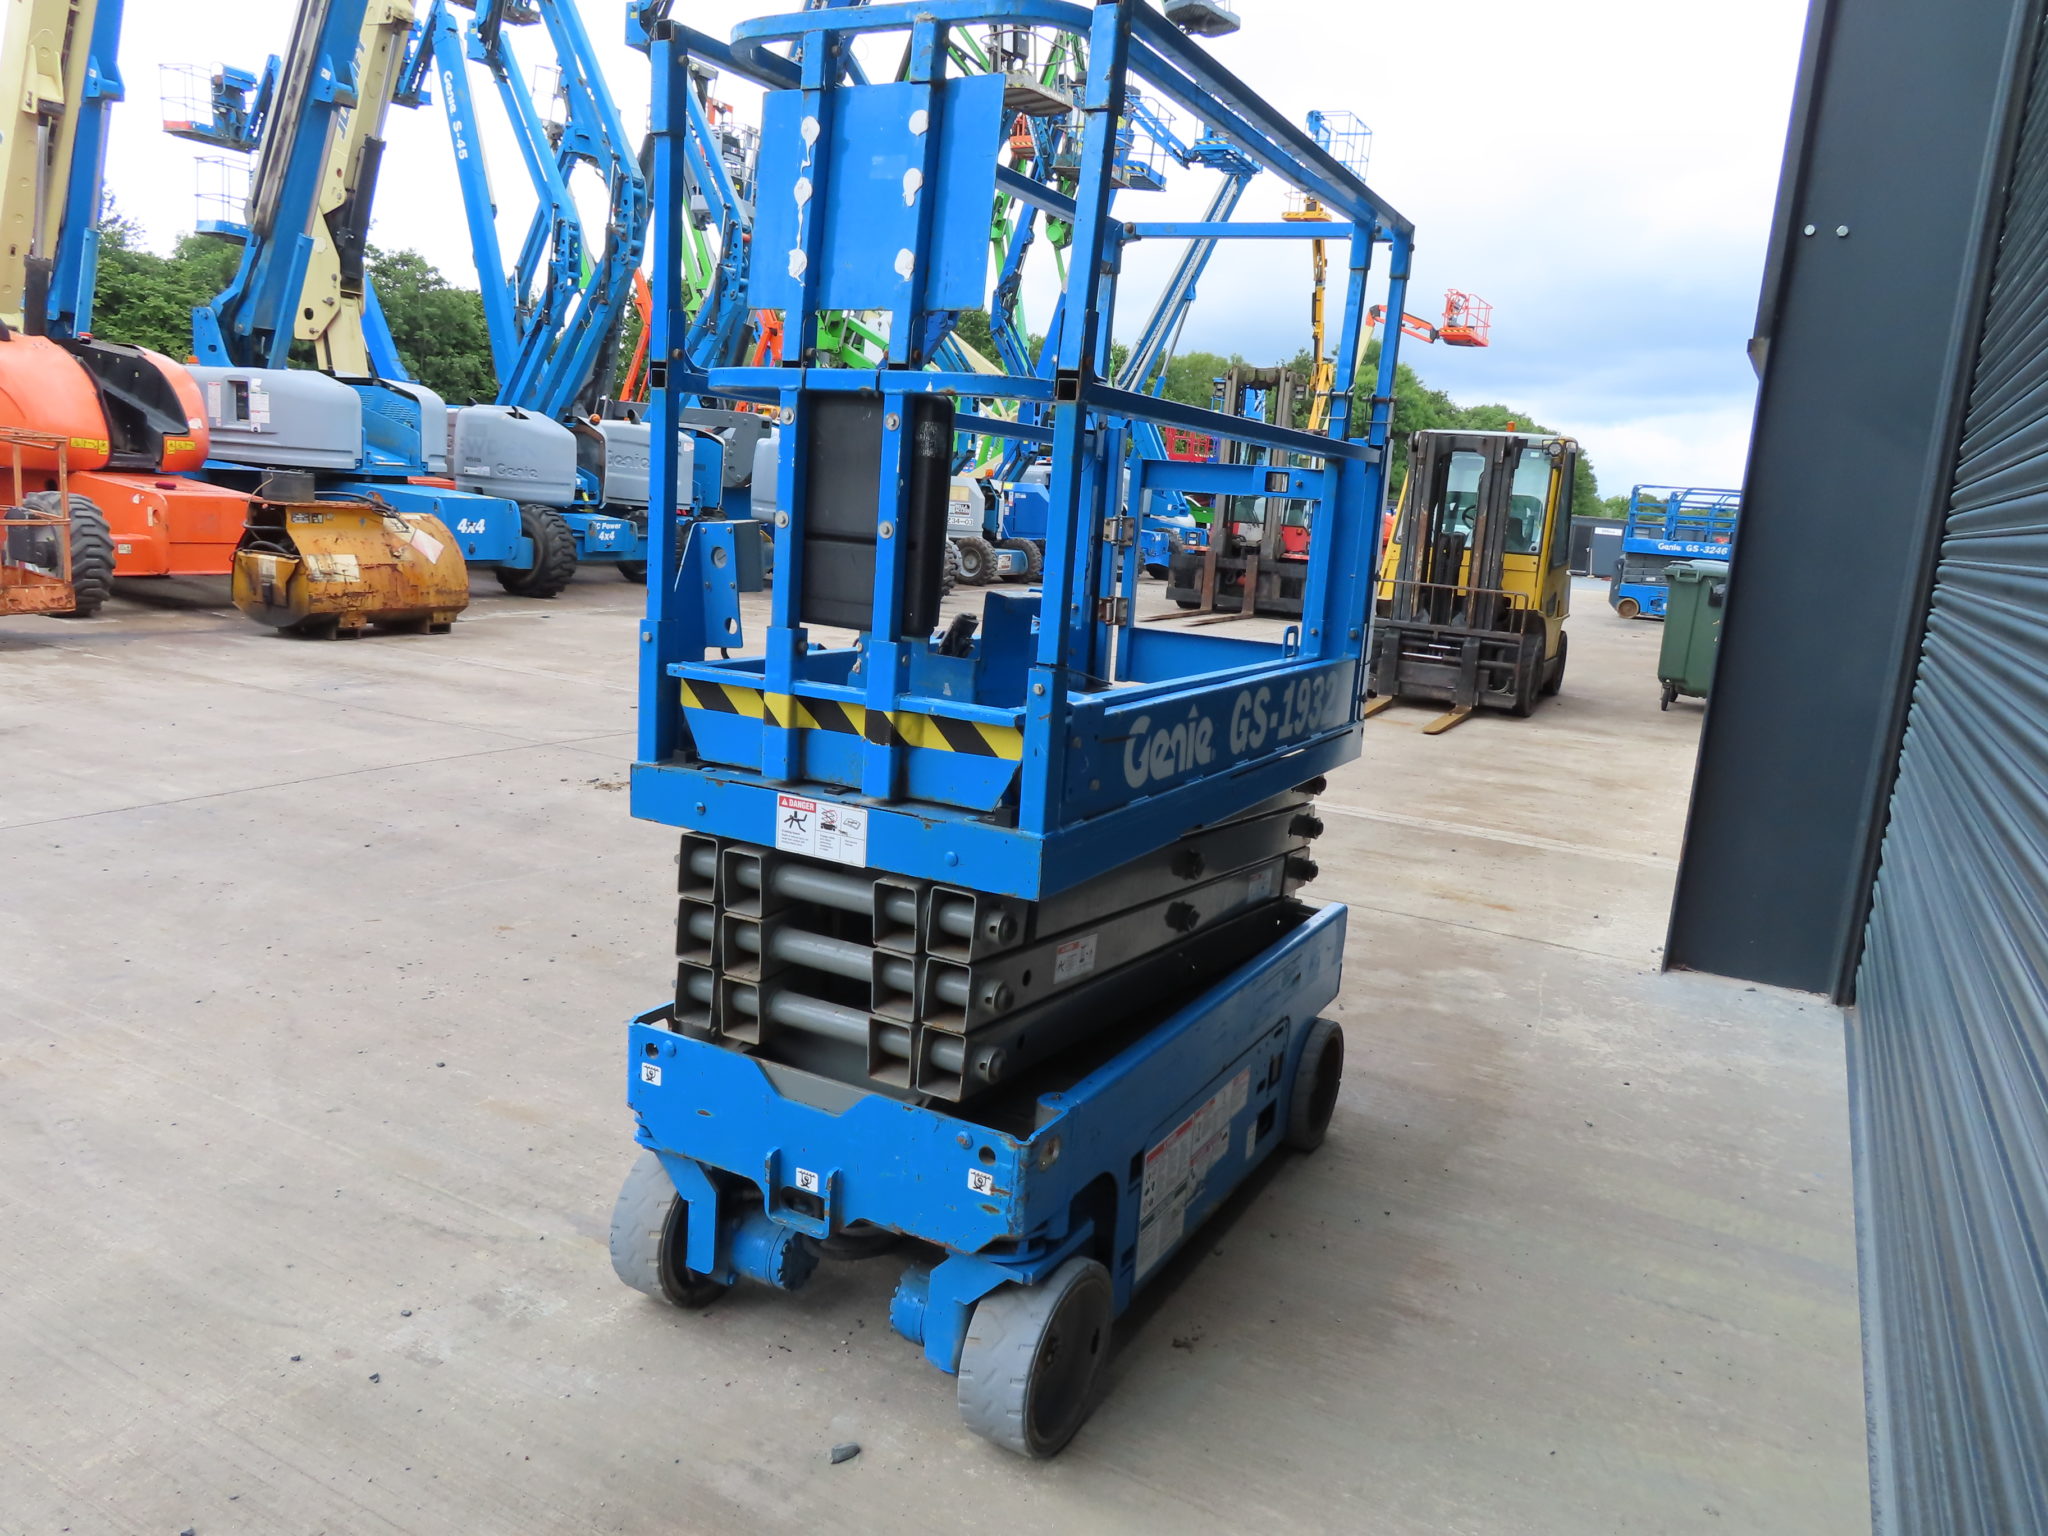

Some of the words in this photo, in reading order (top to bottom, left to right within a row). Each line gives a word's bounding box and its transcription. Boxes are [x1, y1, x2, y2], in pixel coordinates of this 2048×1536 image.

[443, 70, 457, 115] Genie
[453, 121, 469, 160] S-45
[495, 462, 539, 480] Genie
[457, 518, 486, 534] 4x4
[601, 522, 622, 530] Power
[598, 530, 616, 541] 4x4
[1657, 542, 1682, 551] Genie
[1123, 704, 1214, 789] Genie
[1230, 671, 1339, 756] GS-1932
[788, 799, 815, 811] DANGER
